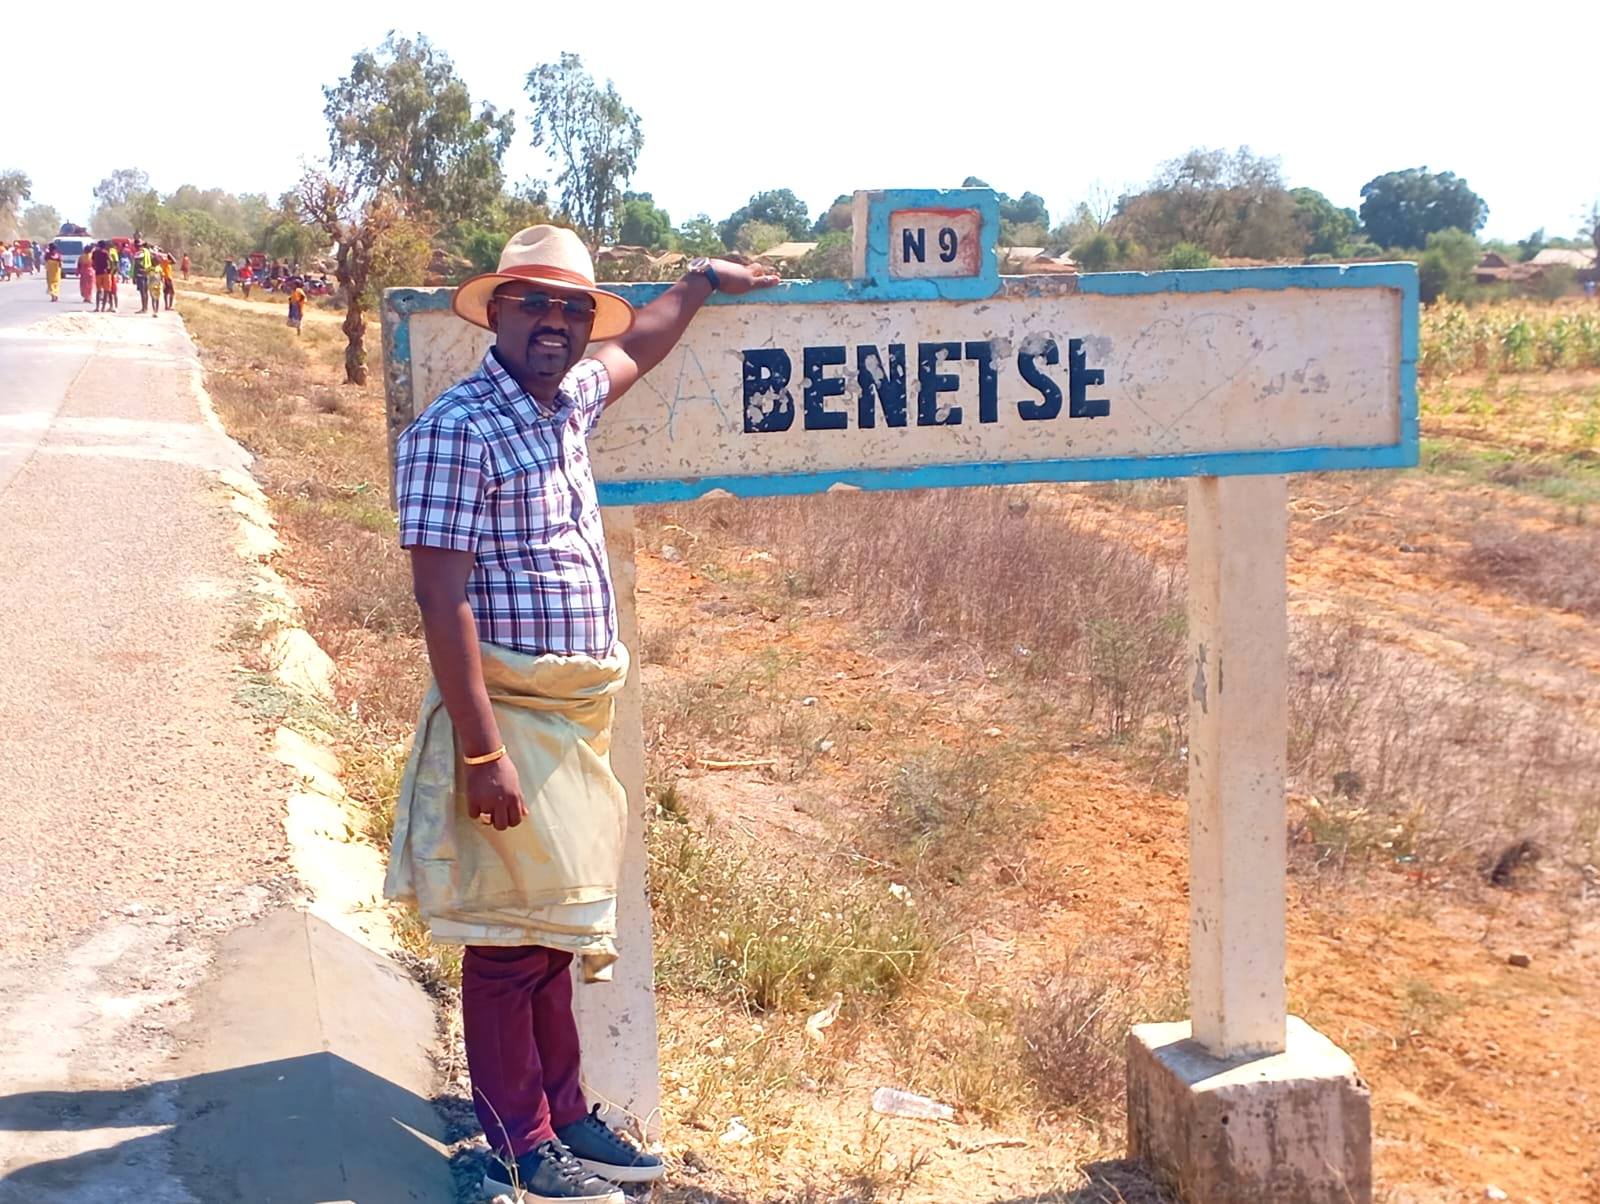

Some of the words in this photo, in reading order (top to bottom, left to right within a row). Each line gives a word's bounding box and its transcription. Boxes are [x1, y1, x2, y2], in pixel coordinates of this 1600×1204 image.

[902, 228, 925, 263] N
[938, 227, 958, 263] 9
[742, 337, 1111, 434] BENETSE
